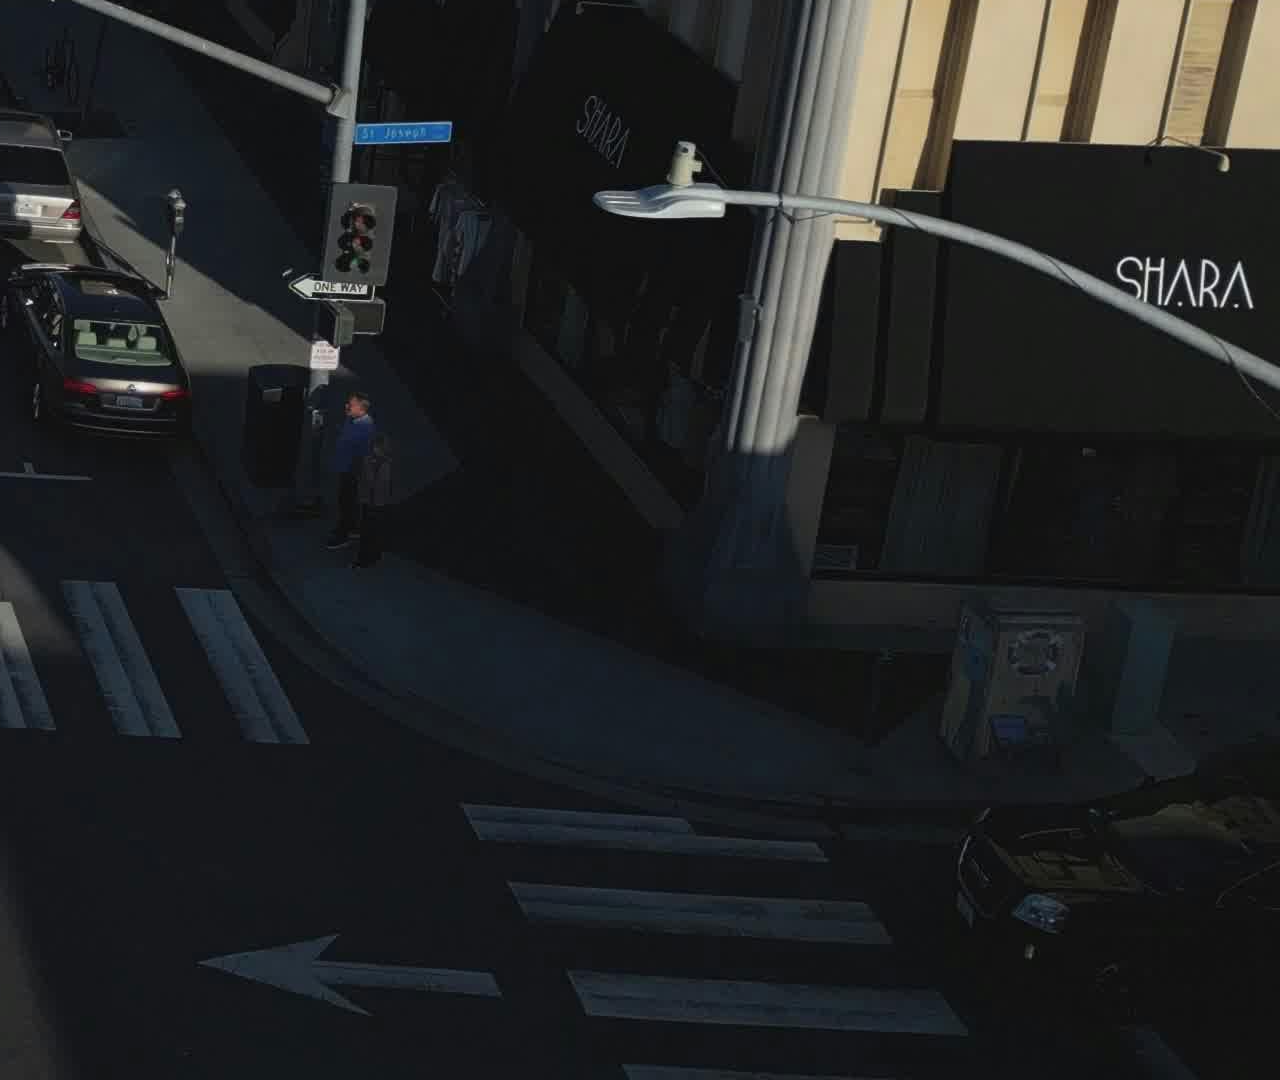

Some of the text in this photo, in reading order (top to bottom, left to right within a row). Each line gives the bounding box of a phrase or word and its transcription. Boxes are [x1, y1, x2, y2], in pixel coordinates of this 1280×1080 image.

[576, 95, 630, 169] SHARA
[314, 282, 364, 293] ONE WAY
[1116, 256, 1254, 309] SHARA
